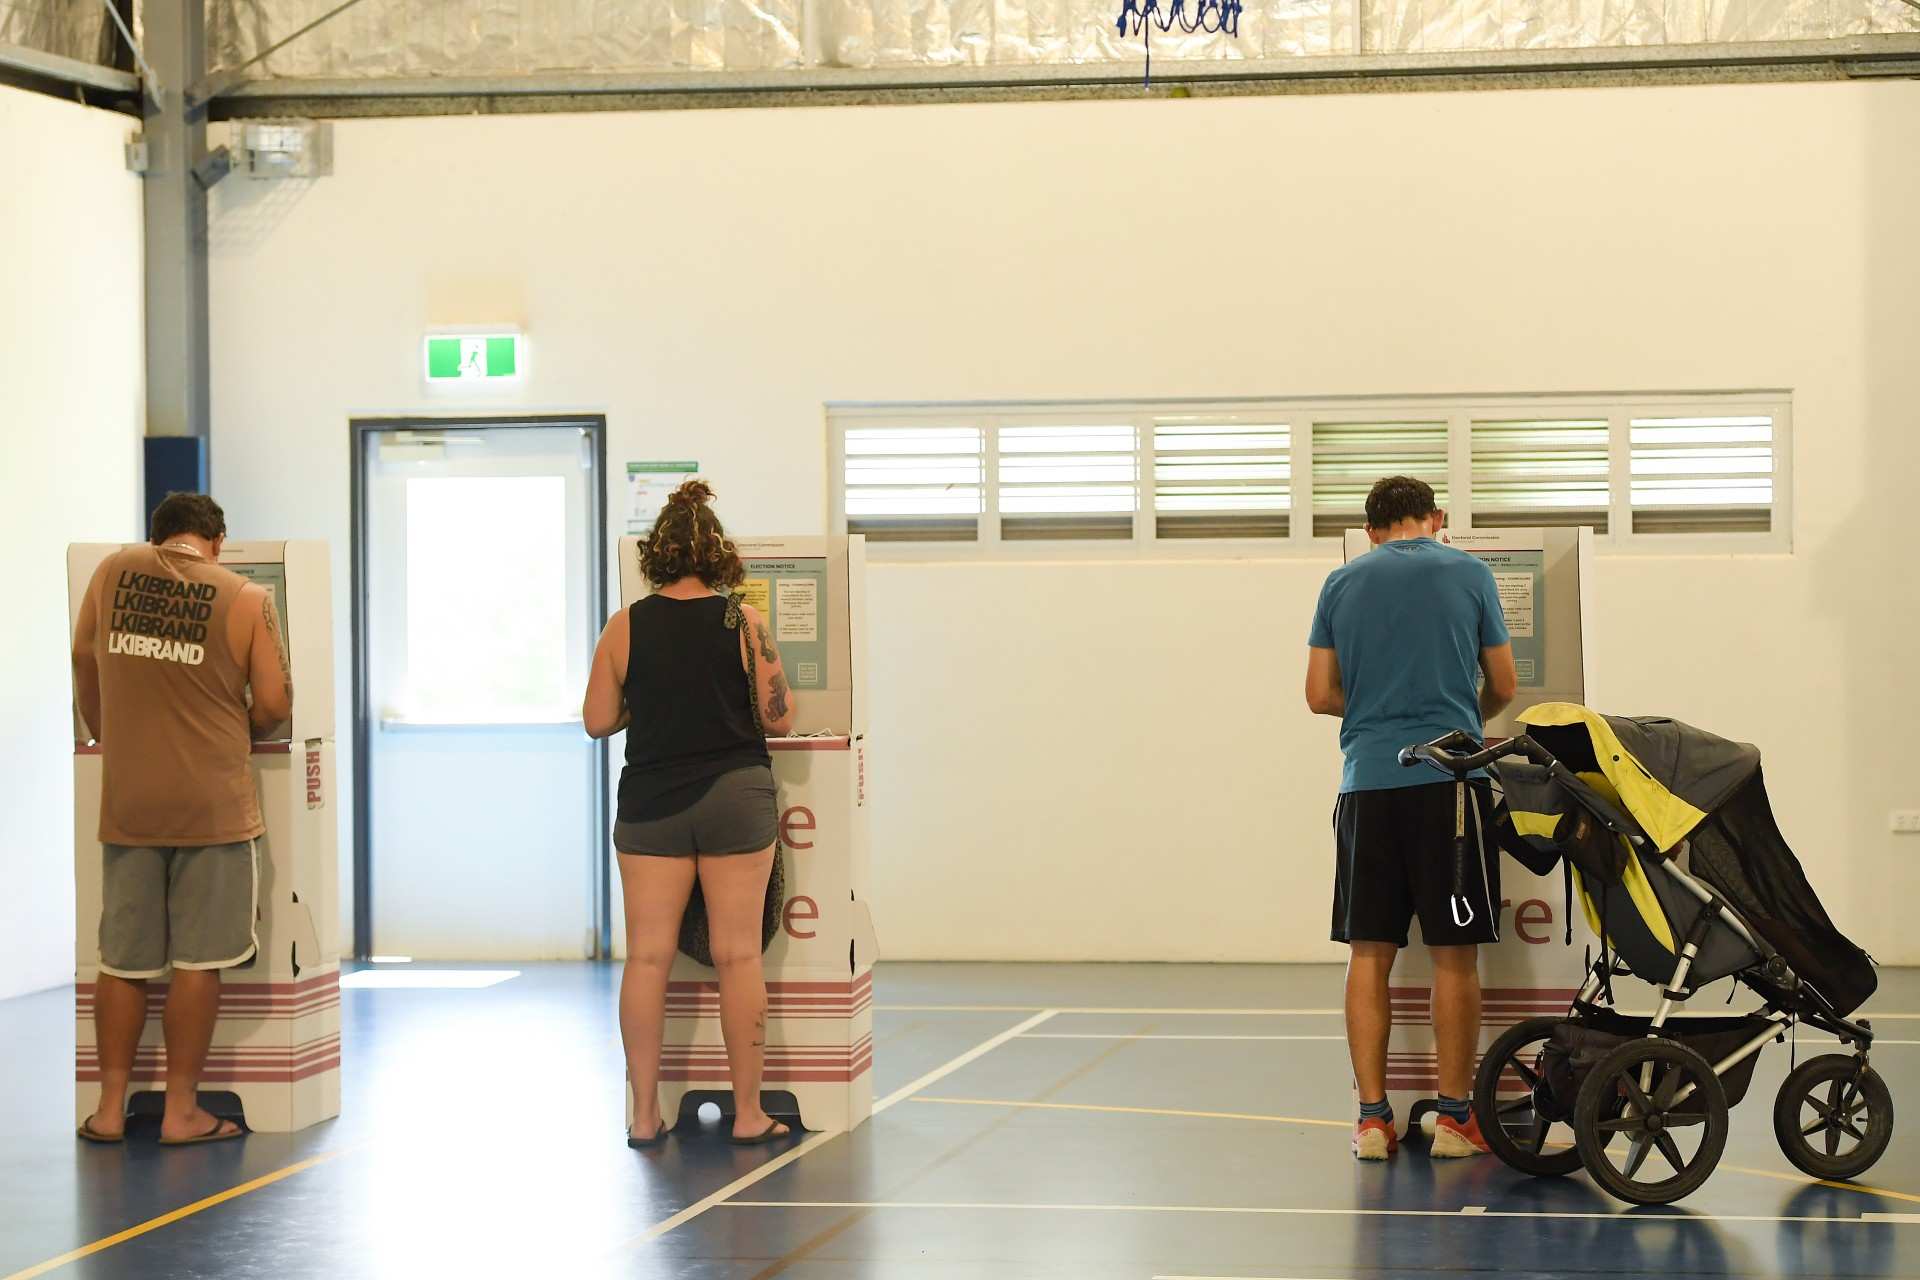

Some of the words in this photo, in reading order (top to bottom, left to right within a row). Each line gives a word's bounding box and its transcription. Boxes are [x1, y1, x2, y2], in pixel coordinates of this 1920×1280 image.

[118, 570, 217, 602] LKIBRAND
[112, 590, 213, 622] LKIBRAND
[110, 611, 208, 643] LKIBRAND
[108, 632, 205, 666] LKIBRAND
[306, 751, 321, 803] PUSH
